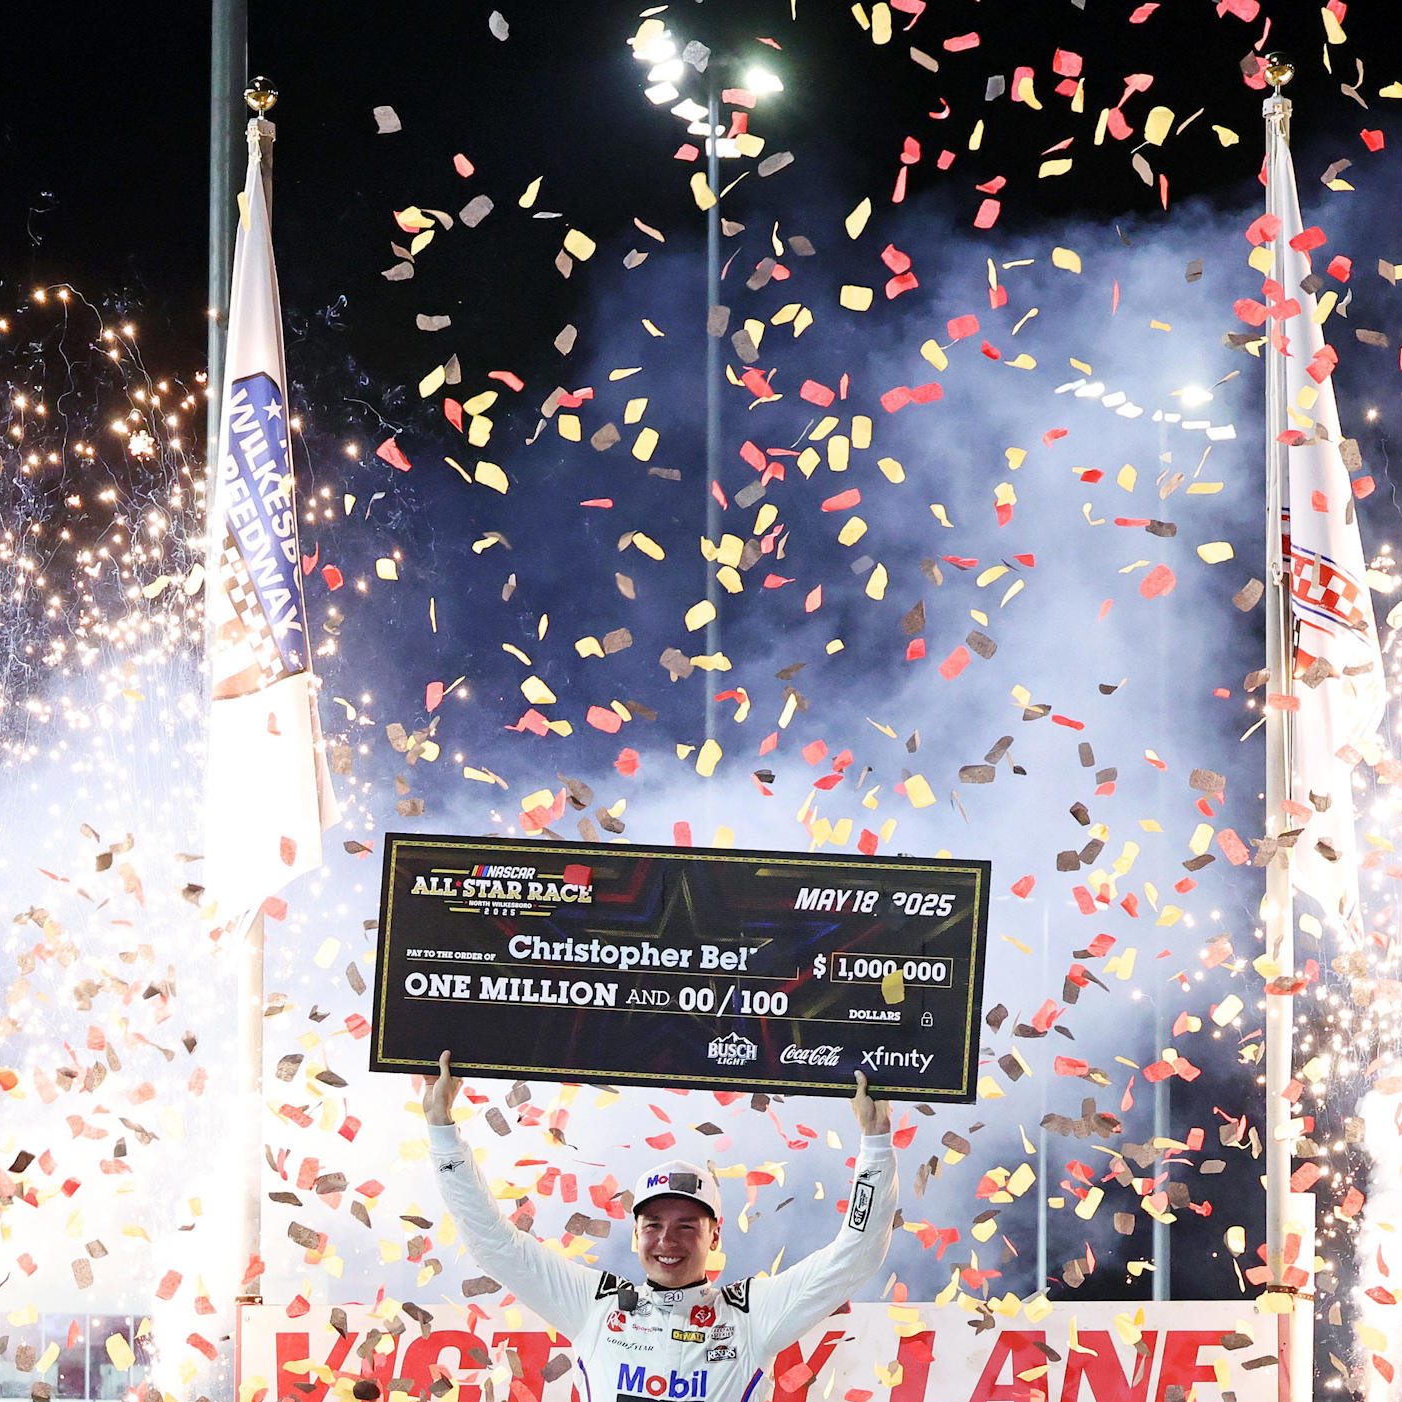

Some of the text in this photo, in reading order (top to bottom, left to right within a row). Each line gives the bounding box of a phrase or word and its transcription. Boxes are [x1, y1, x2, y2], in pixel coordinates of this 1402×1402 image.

[487, 865, 536, 880] NASCAR
[411, 876, 593, 904] ALL STAR RACE
[794, 887, 853, 912] MAY
[468, 900, 533, 909] NORTH WILKESBORO
[406, 949, 496, 962] PAY TO THE ORDER OF
[508, 934, 758, 972] Christopher Bel
[838, 957, 947, 983] 1,000000
[404, 972, 471, 999] ONE
[479, 975, 618, 1007] MILLION
[625, 988, 671, 1007] AND
[849, 1008, 901, 1022] DOLLARS
[707, 1034, 758, 1062] BUSCH
[861, 1046, 935, 1074] xfinity
[716, 1058, 747, 1067] LIGHT
[617, 1363, 708, 1398] Mobil
